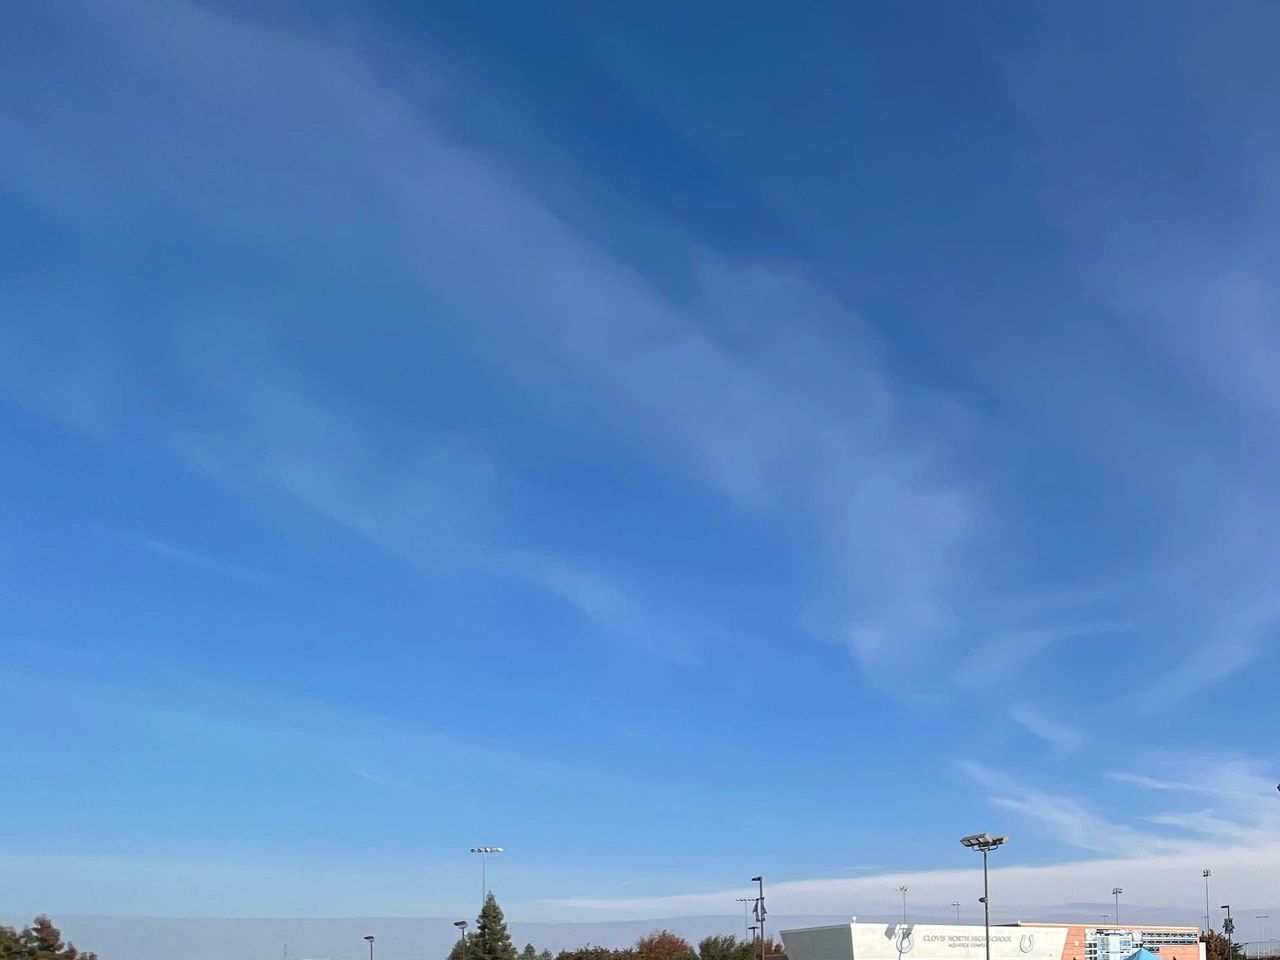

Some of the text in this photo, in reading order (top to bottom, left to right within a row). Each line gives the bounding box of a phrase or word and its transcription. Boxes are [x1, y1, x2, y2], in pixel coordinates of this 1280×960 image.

[922, 934, 946, 942] CLOVIS
[947, 935, 969, 943] NORTH
[988, 935, 1012, 943] SCHOOL
